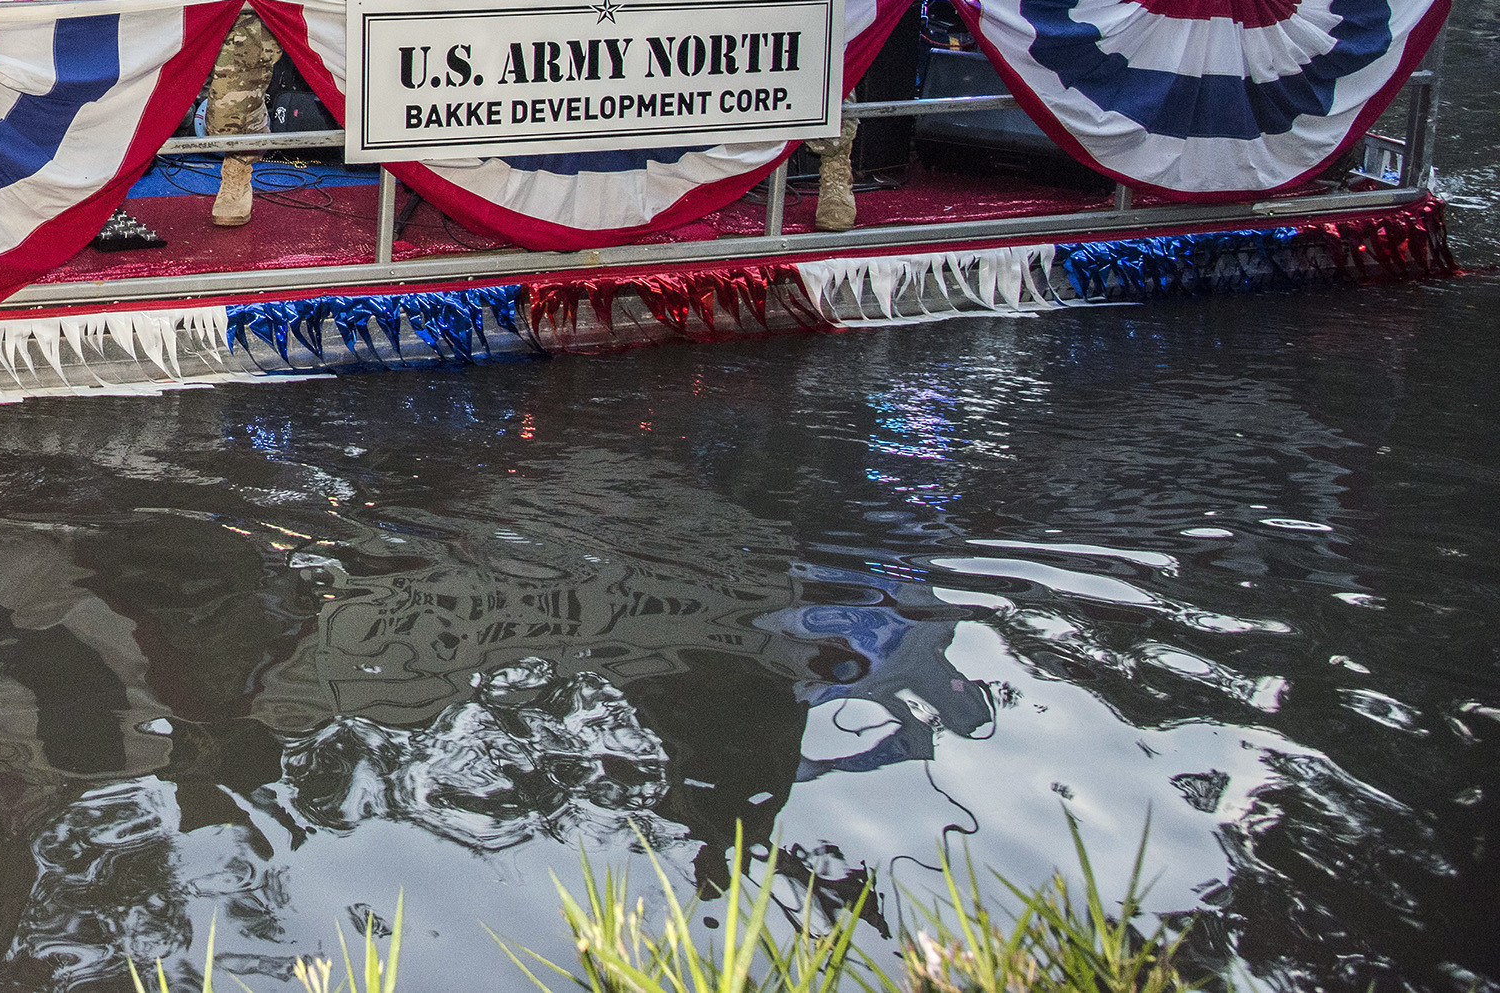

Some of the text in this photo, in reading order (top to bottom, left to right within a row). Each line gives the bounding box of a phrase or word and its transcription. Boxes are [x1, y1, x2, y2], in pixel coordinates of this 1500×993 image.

[398, 32, 802, 89] U.S. ARMY NORTH
[405, 87, 792, 129] BAKKE DEVELOPMENT CORP.
